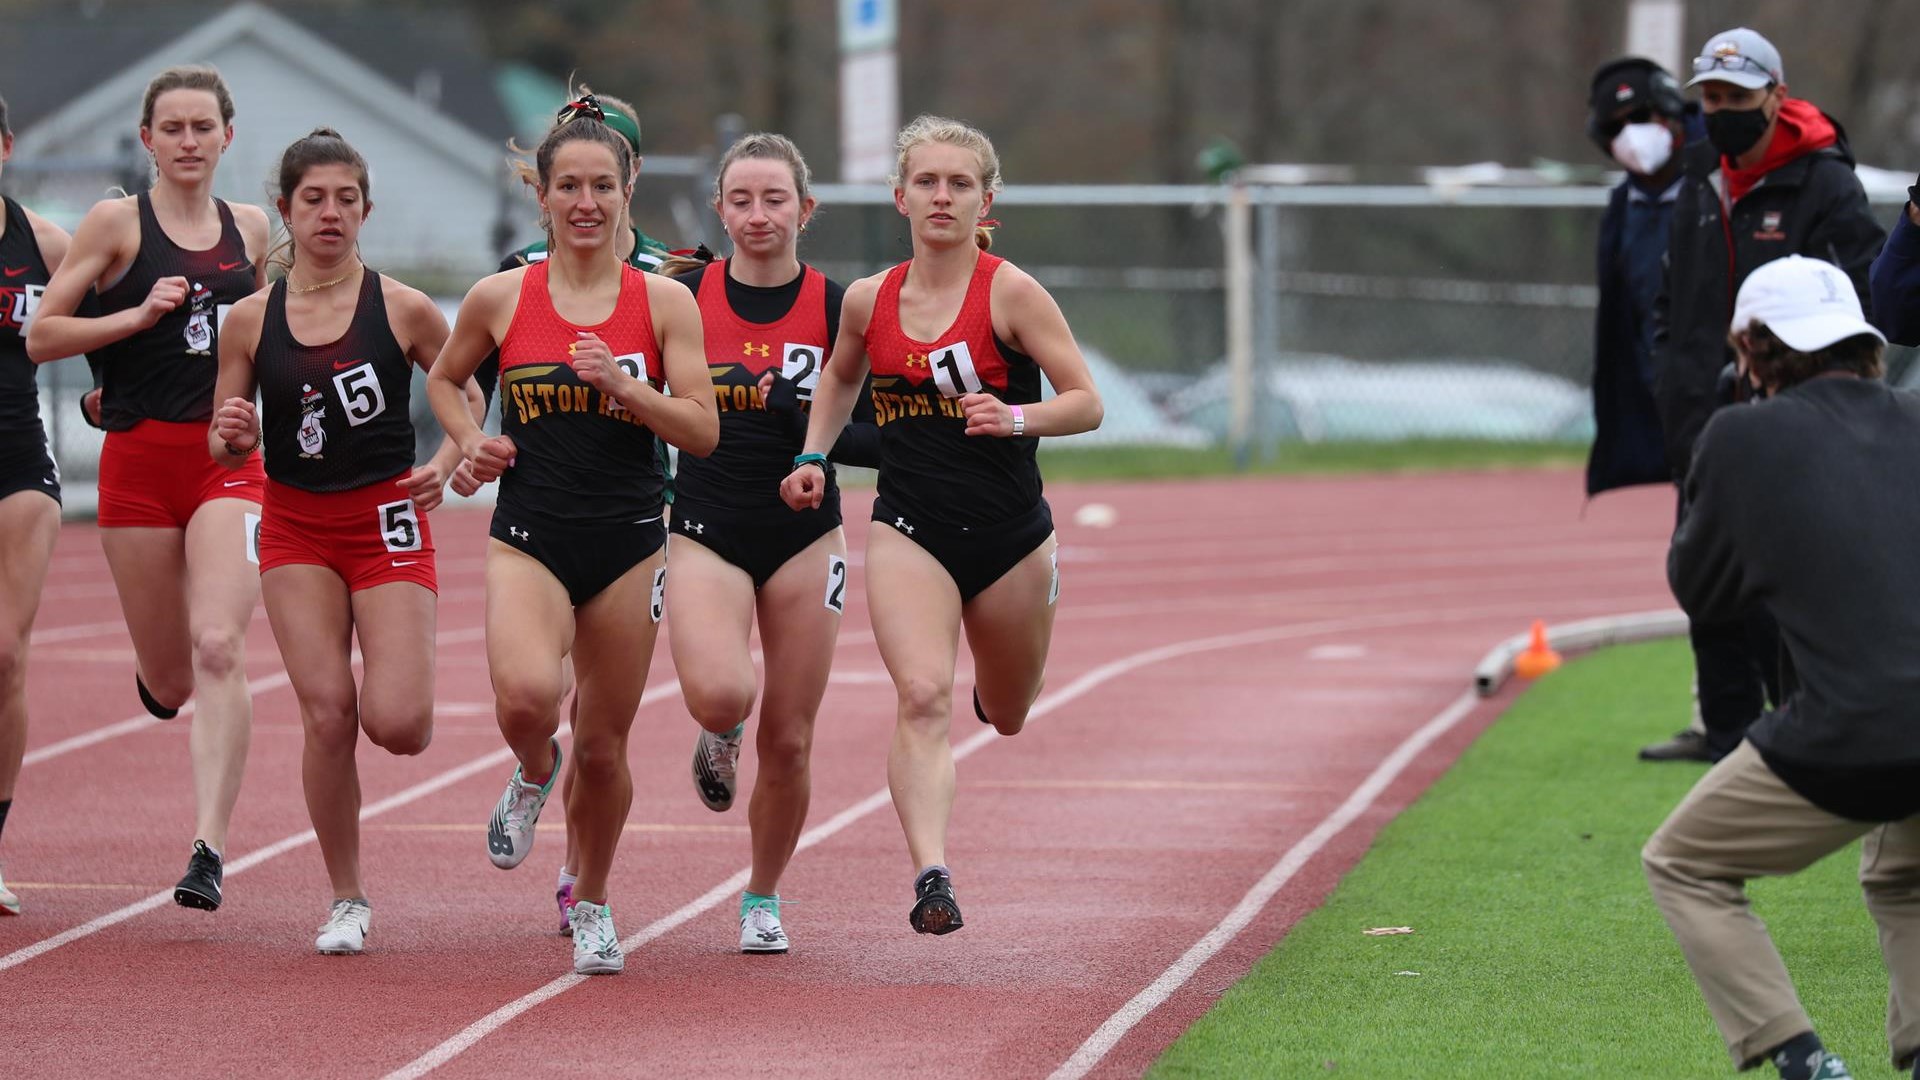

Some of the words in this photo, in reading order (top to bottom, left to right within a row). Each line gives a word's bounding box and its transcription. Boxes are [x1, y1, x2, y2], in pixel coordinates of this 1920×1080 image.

[341, 370, 378, 419] 5
[788, 348, 817, 397] 2
[936, 349, 968, 395] 1
[510, 383, 590, 425] SETON
[713, 384, 764, 412] TON
[385, 503, 415, 548] 5
[829, 561, 845, 611] 2
